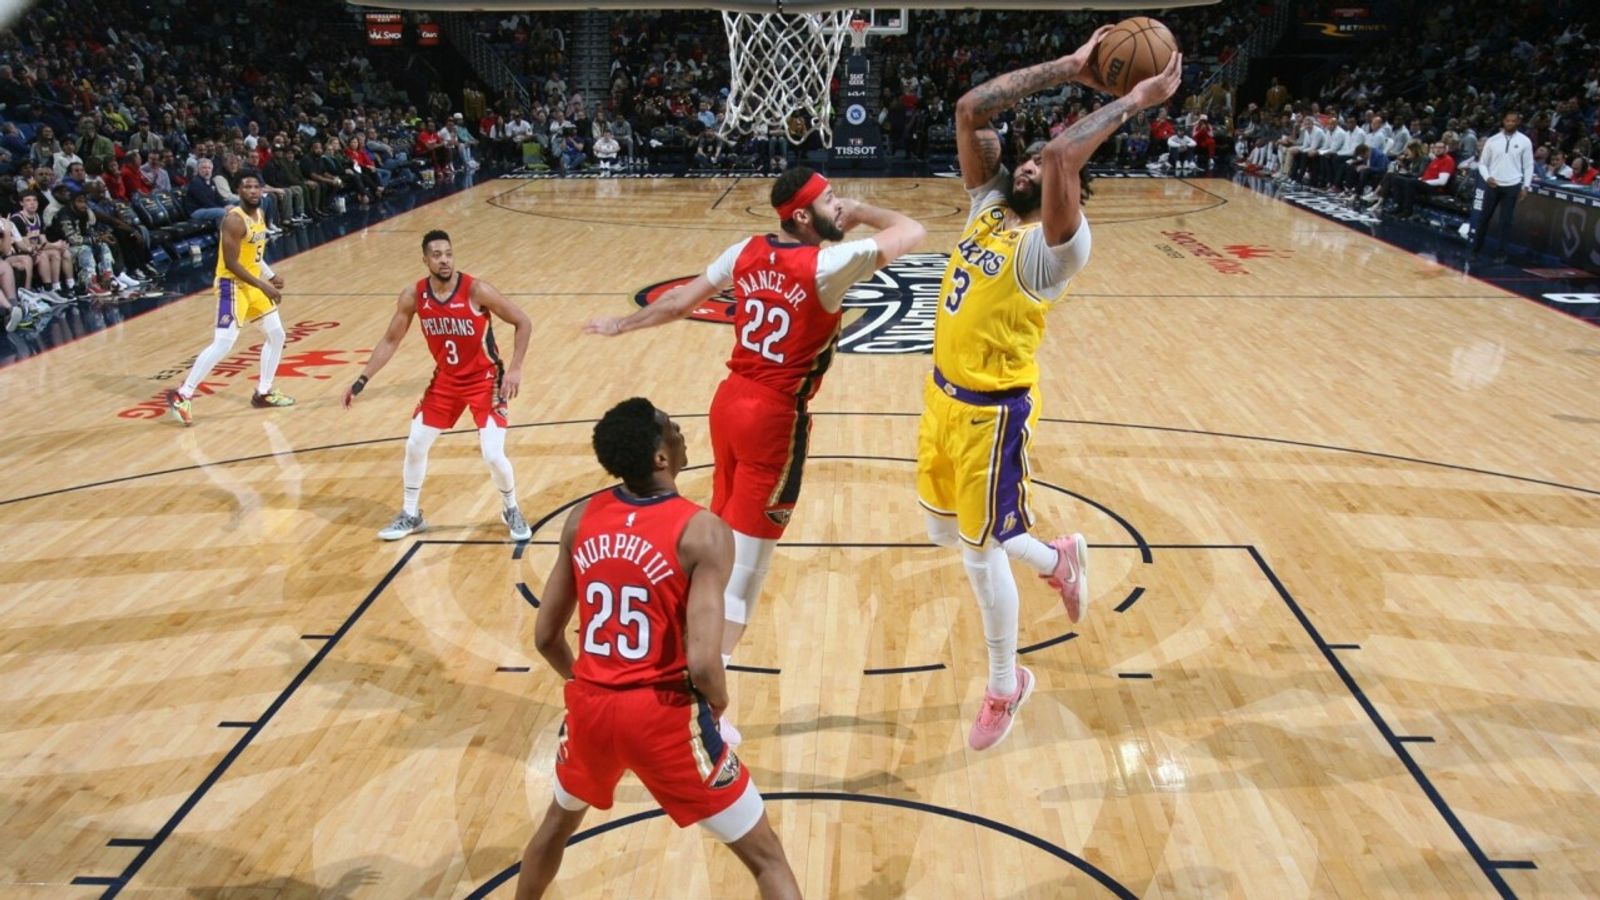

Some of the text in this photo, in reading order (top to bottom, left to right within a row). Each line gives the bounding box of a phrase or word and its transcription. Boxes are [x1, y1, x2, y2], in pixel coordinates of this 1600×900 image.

[834, 146, 877, 155] TISSOT
[254, 244, 263, 263] 5
[736, 269, 807, 312] NANCE JR.
[944, 266, 971, 315] 3
[421, 317, 475, 336] PELICANS
[740, 297, 790, 364] 22
[444, 339, 460, 366] 3
[573, 532, 674, 586] MURPHY III
[583, 581, 651, 661] 25
